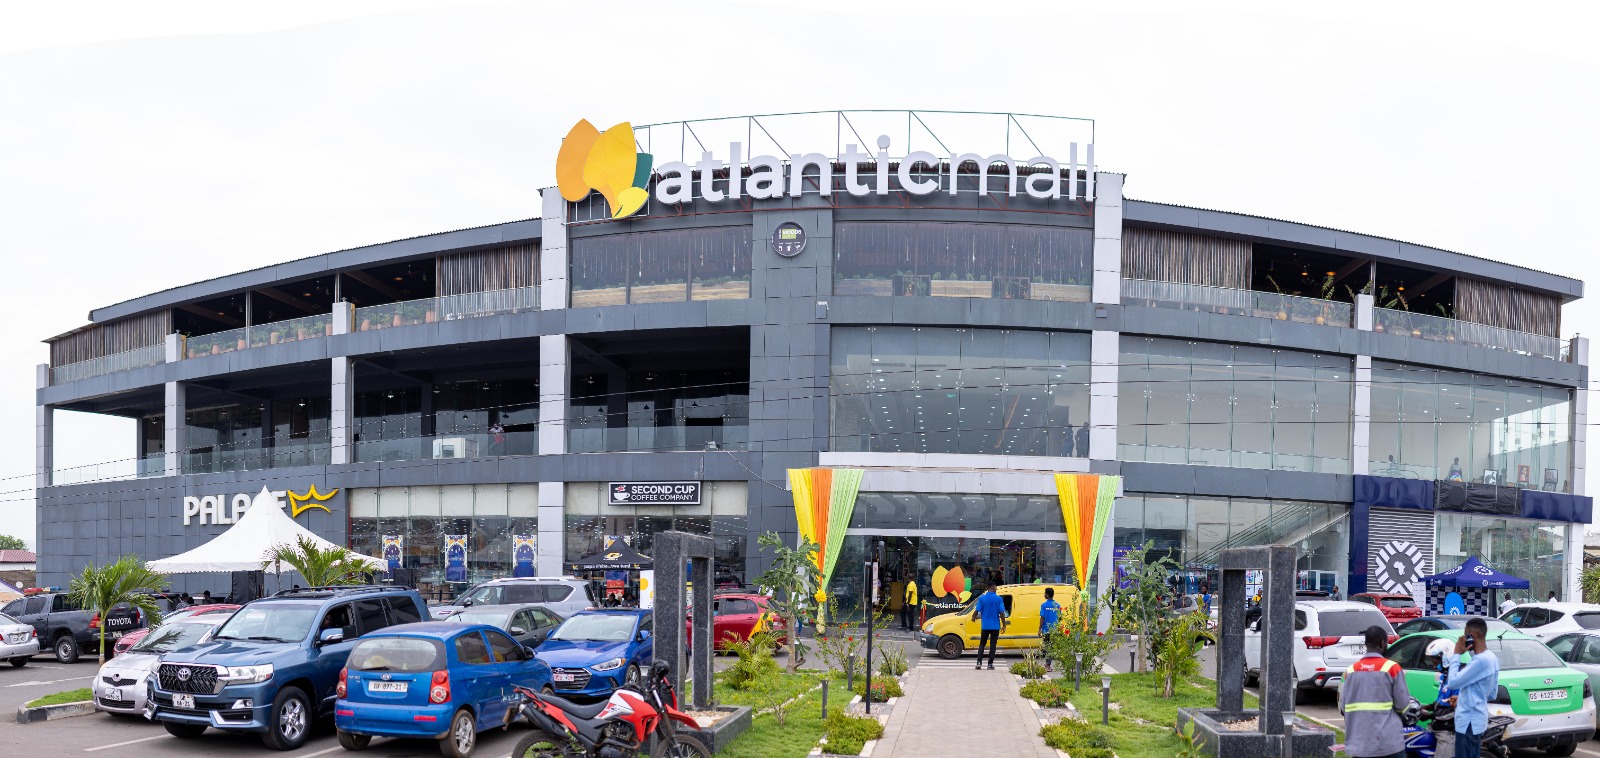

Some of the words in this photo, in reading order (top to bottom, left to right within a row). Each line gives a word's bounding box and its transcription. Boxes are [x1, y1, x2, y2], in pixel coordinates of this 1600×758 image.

[631, 485, 673, 494] SECOND
[674, 485, 696, 494] CUP
[183, 491, 287, 526] PALAE
[107, 617, 132, 627] TOYOTA
